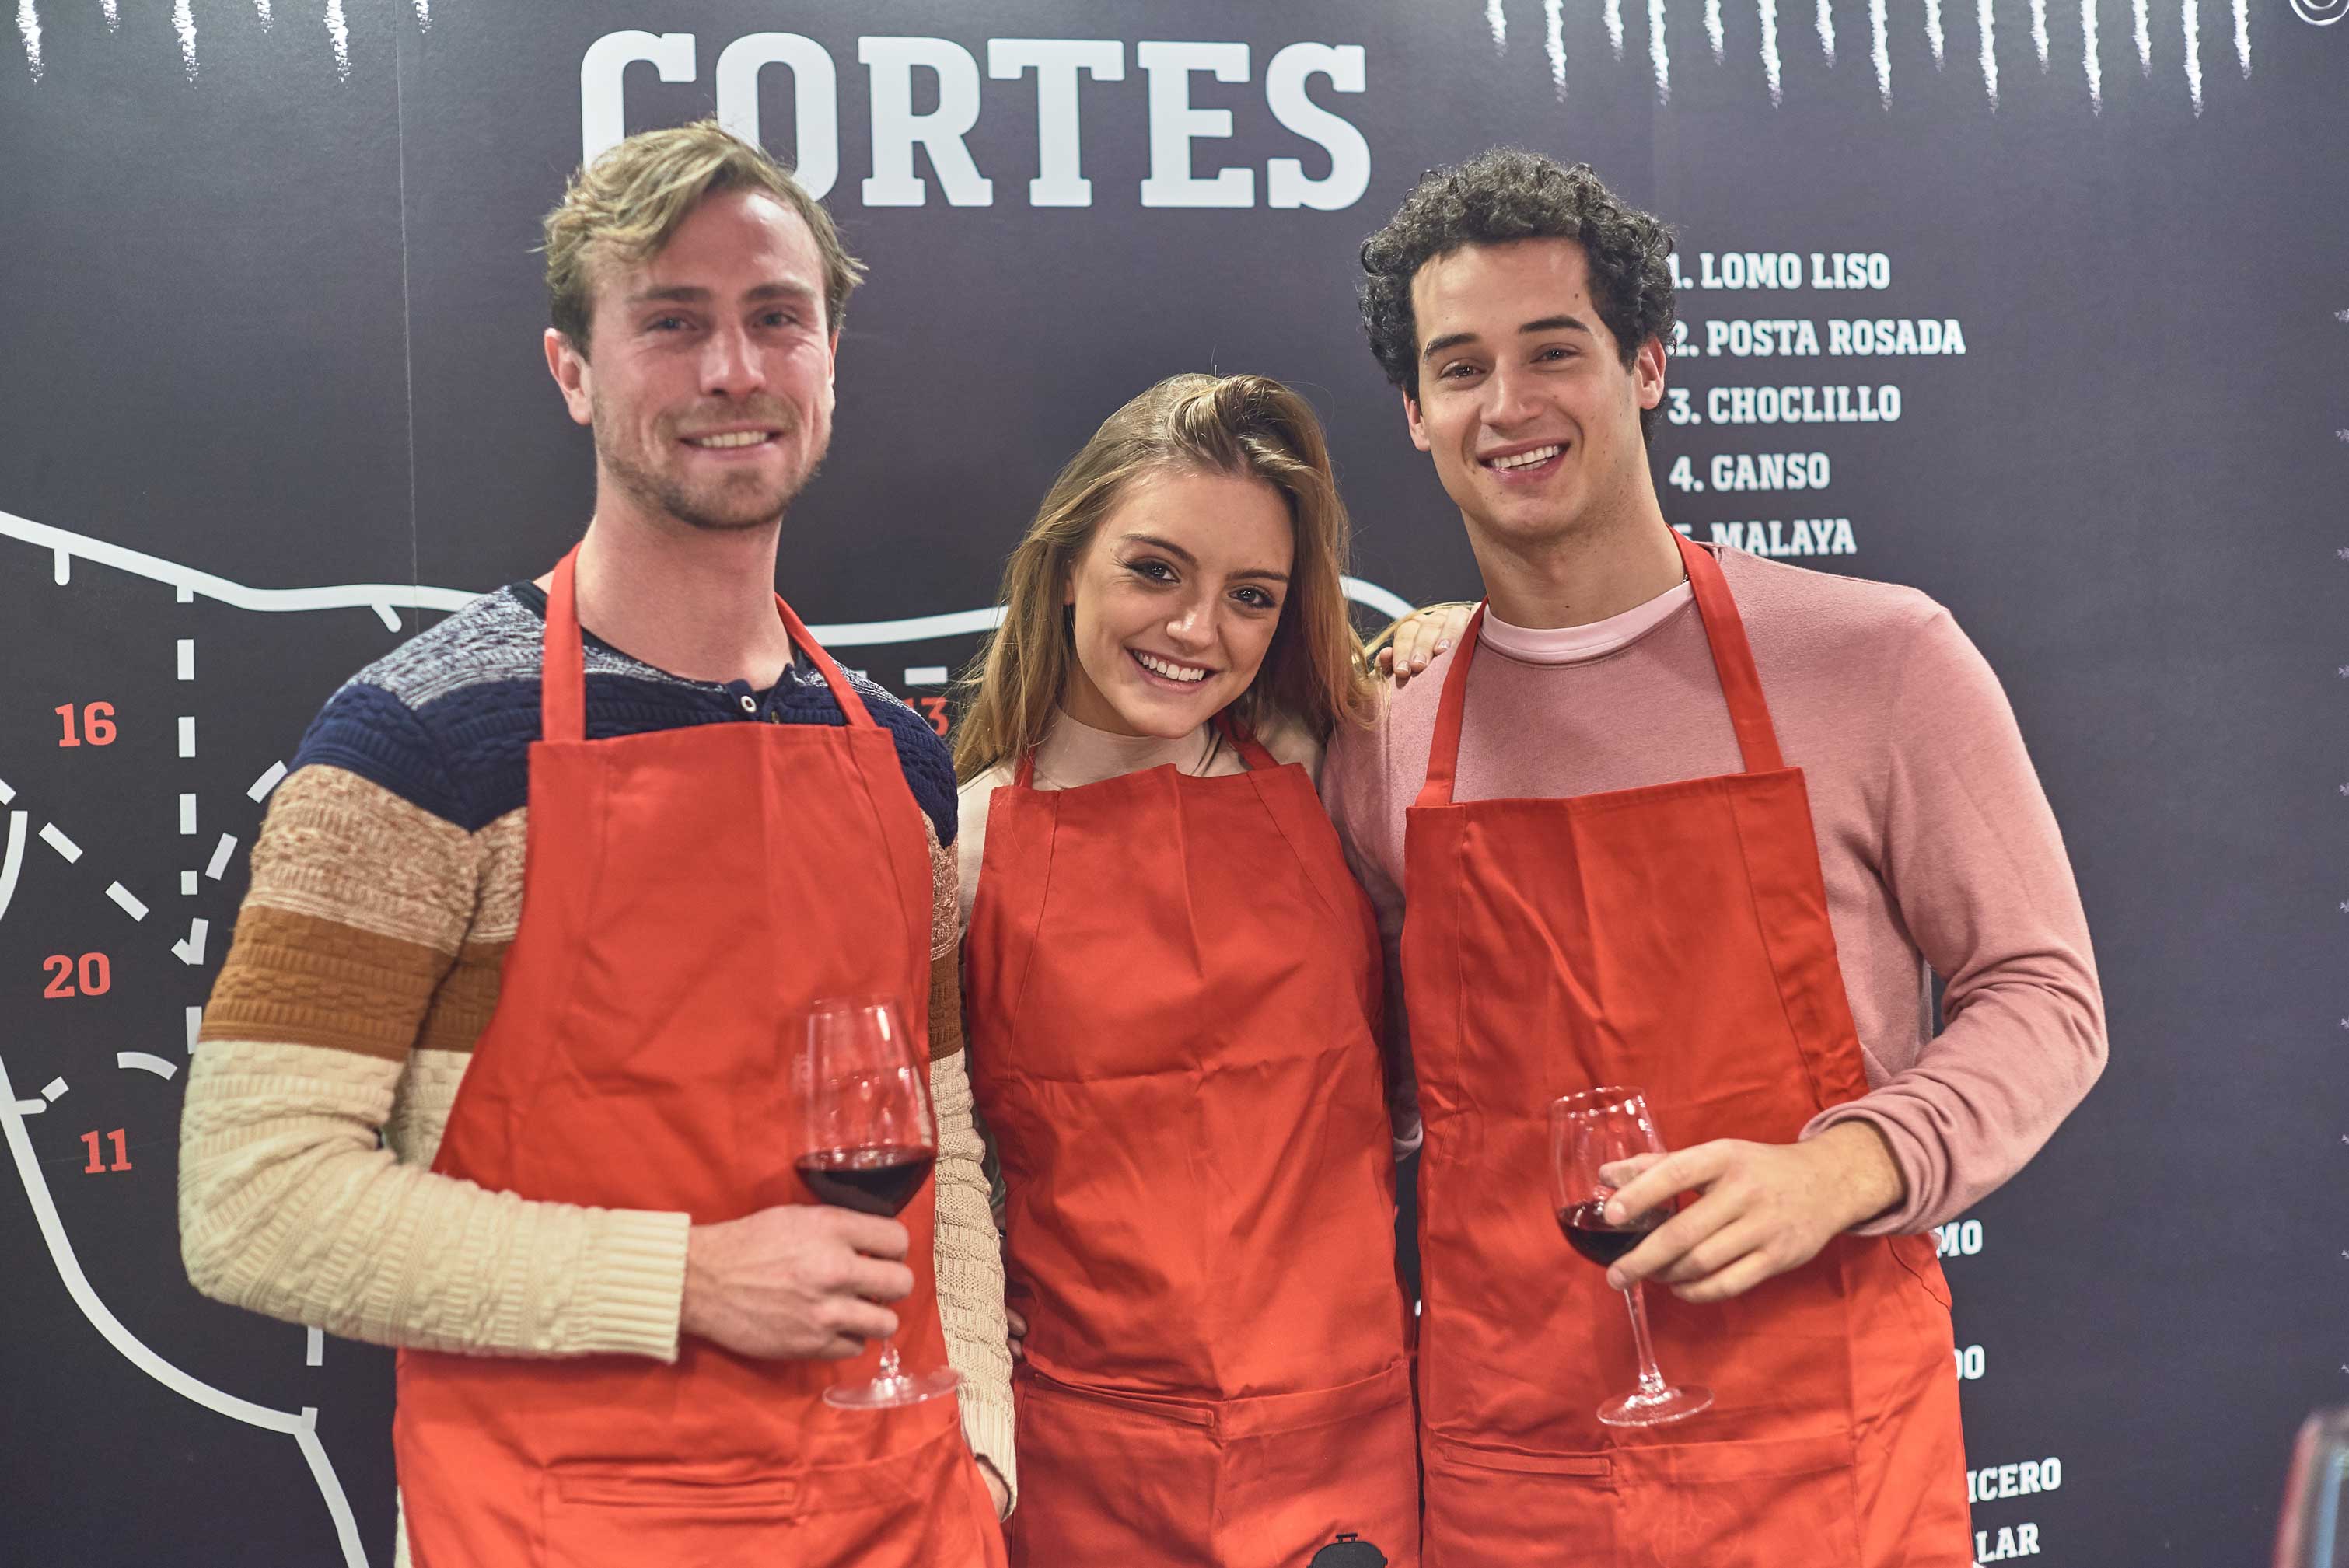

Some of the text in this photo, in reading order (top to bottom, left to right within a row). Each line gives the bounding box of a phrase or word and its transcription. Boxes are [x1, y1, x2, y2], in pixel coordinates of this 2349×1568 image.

[581, 30, 1372, 211] CORTES
[1666, 252, 1891, 290] 1. LOMO LISO
[1666, 319, 1966, 358] 2. POSTA ROSADA
[1667, 385, 1902, 425] 3. CHOCLILLO
[1669, 452, 1831, 493] 4. GANSO
[1710, 519, 1858, 557] MALAYA
[54, 701, 117, 747] 16
[904, 697, 949, 736] 3
[43, 952, 111, 1000] 20
[80, 1128, 133, 1174] 11
